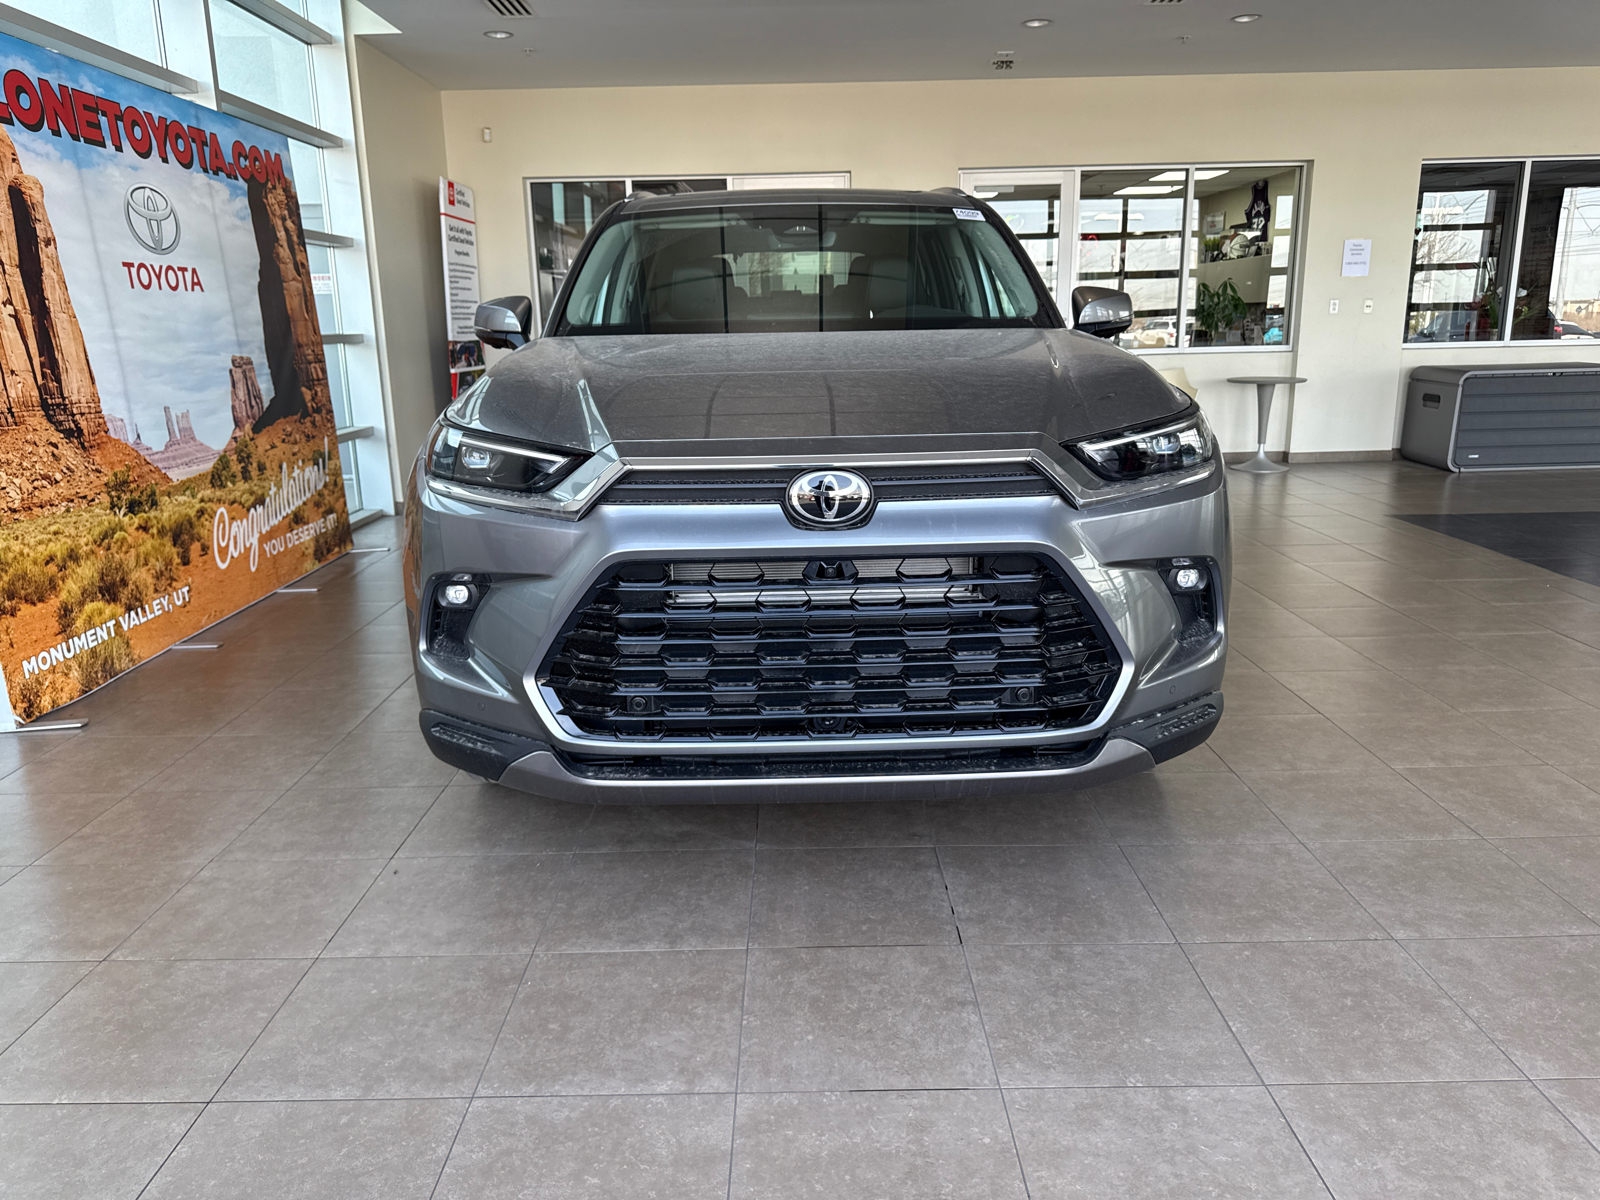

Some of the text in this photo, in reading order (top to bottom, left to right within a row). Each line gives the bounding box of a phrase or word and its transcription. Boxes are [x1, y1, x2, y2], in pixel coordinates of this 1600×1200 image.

[122, 261, 204, 292] TOYOTA
[213, 435, 330, 572] Congratulations!
[263, 513, 338, 557] YOU DESERVE IT!
[22, 586, 190, 679] MONUMENT VALLEY, UT
